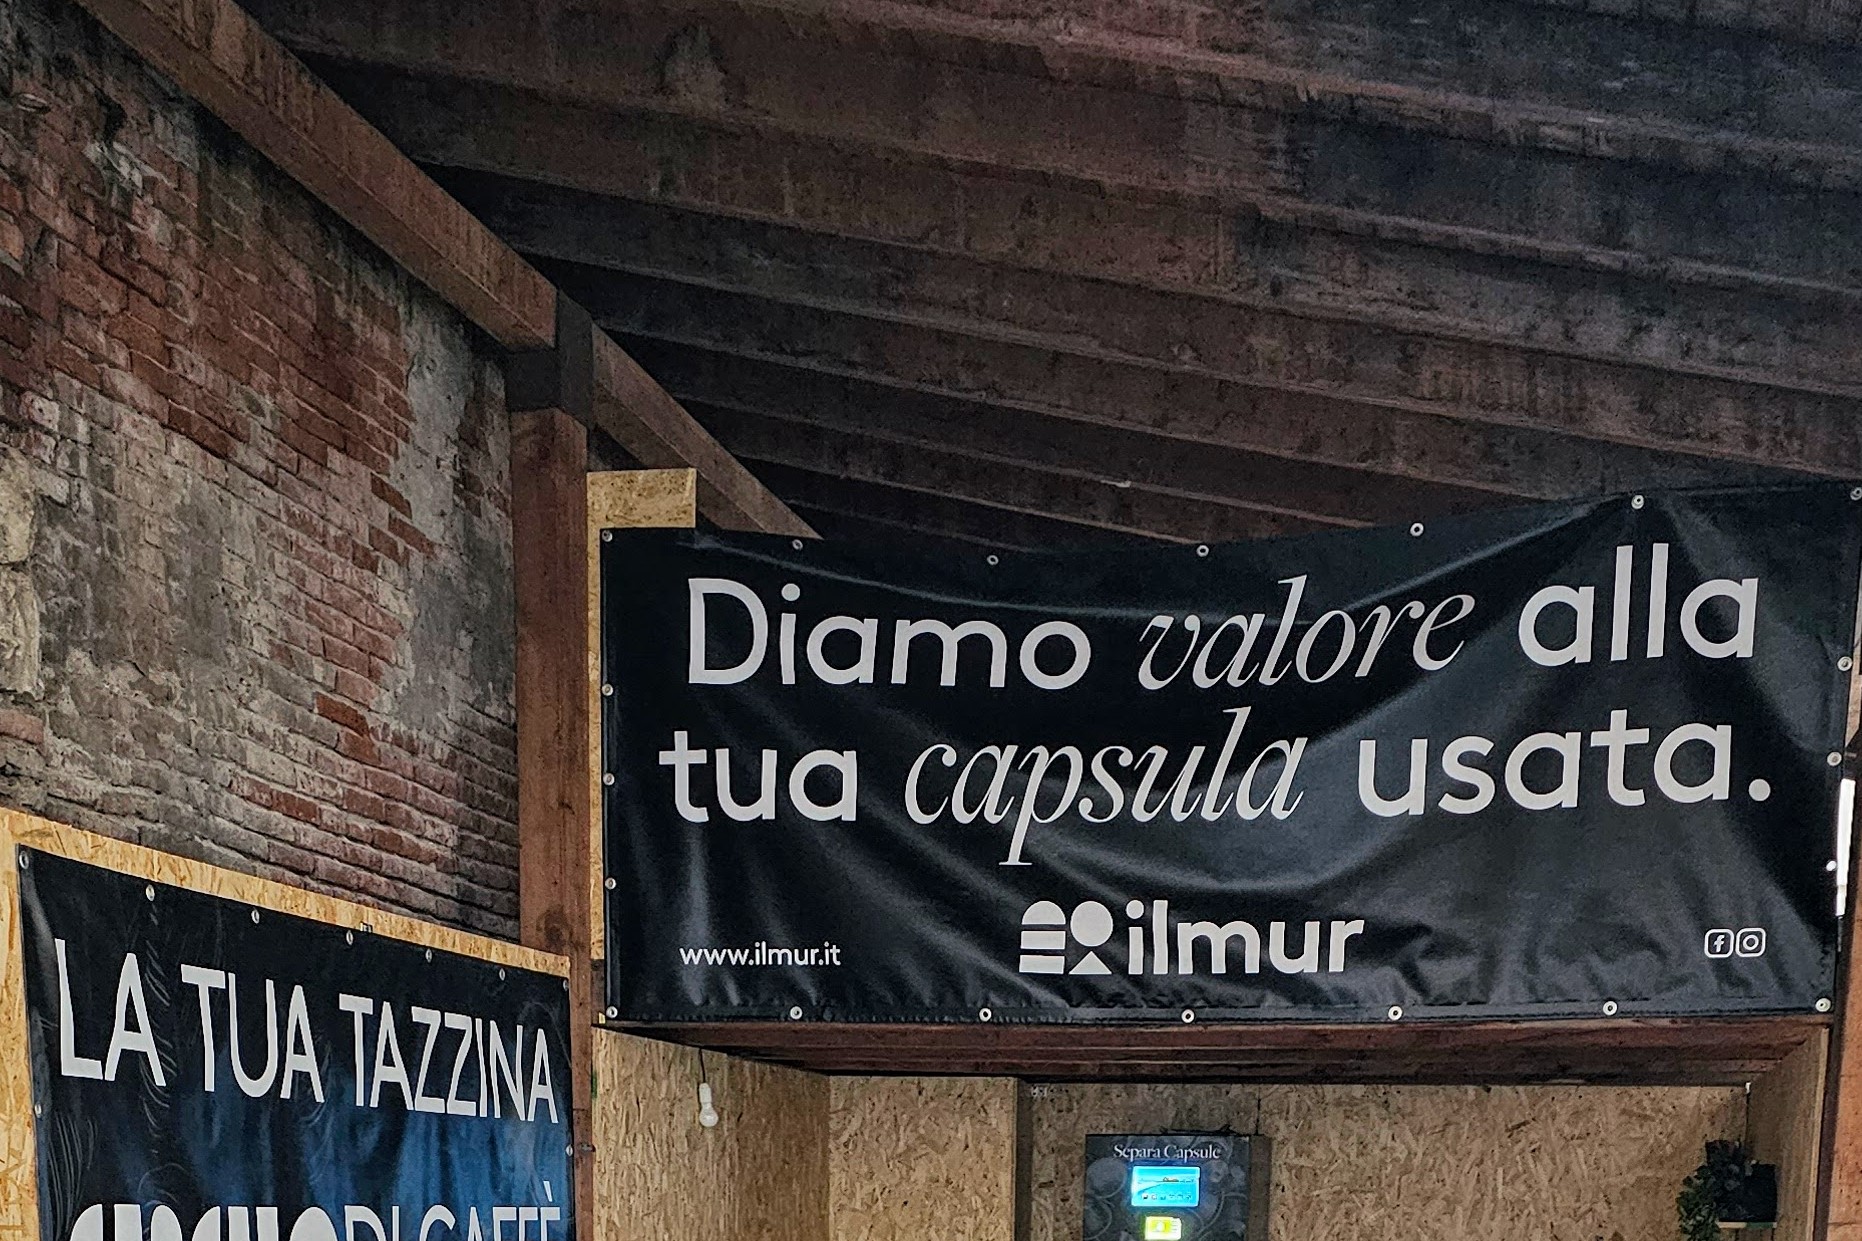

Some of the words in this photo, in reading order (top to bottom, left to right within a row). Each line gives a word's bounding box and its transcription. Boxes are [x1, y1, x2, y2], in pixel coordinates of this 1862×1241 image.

[687, 576, 1090, 689] Diamo
[1138, 574, 1473, 689] valore
[1518, 543, 1759, 667] alla
[659, 729, 858, 823] tua
[905, 707, 1307, 865] capsula
[1359, 707, 1772, 817] usata.
[679, 941, 841, 966] www.ilmur.it
[1126, 899, 1364, 975] ilmur
[54, 938, 166, 1087] LA
[181, 964, 324, 1104] TUA
[339, 993, 558, 1123] TAZZINA
[1113, 1144, 1160, 1161] Separa
[1163, 1145, 1222, 1162] Capsule
